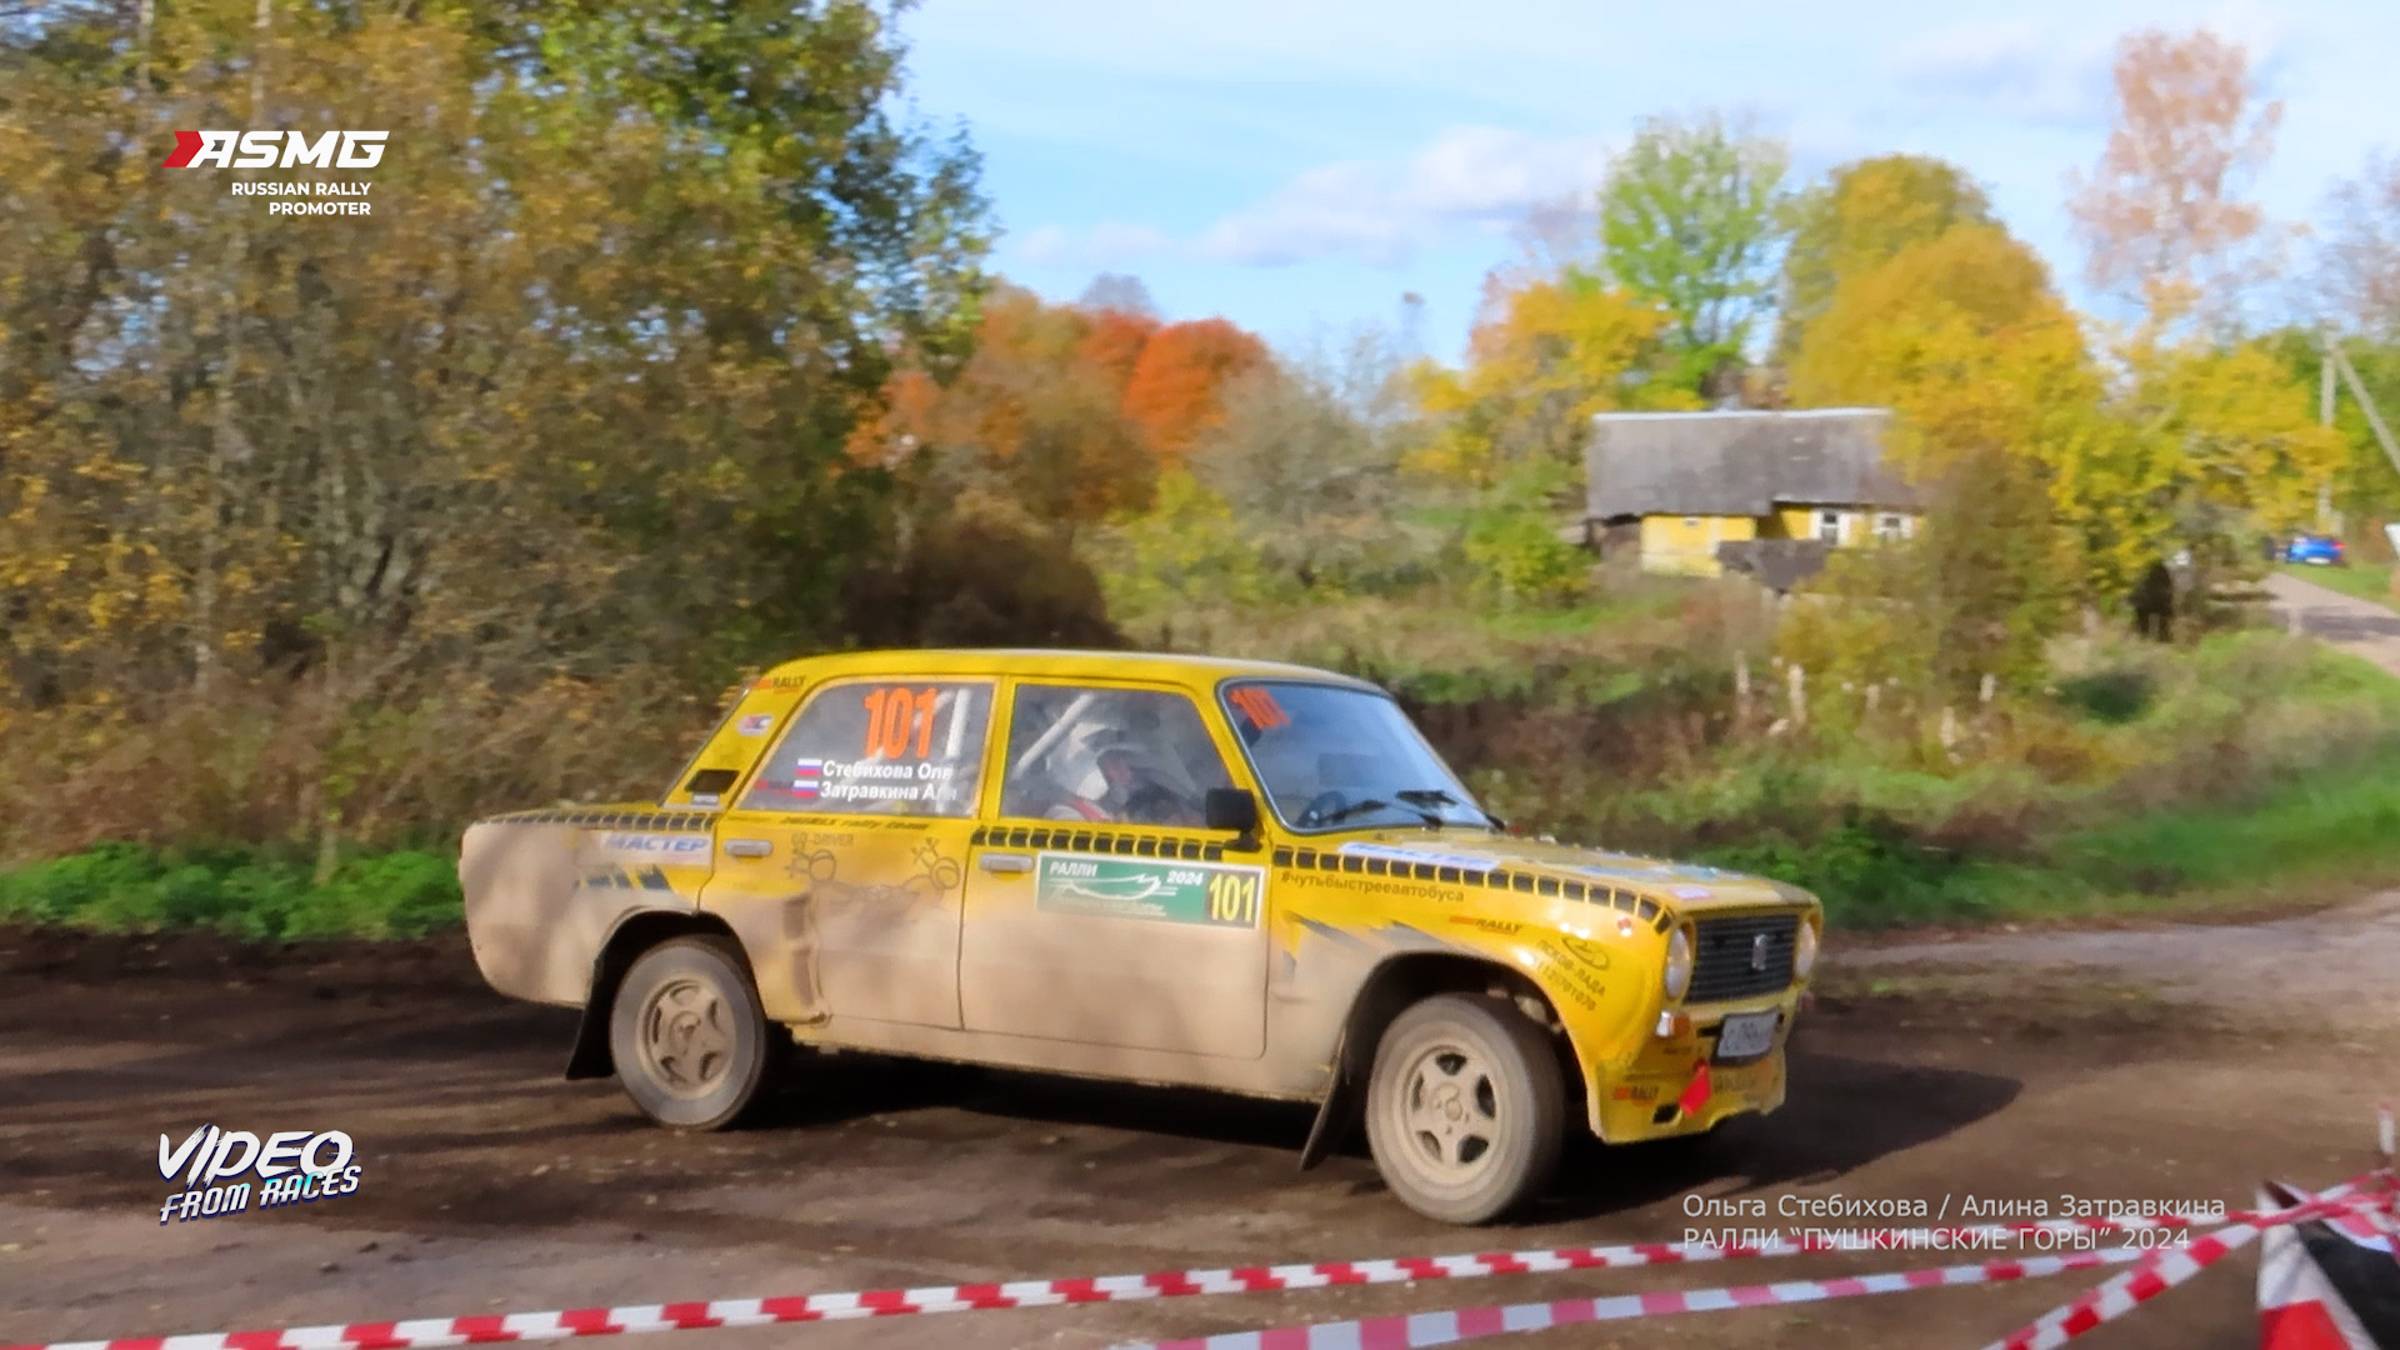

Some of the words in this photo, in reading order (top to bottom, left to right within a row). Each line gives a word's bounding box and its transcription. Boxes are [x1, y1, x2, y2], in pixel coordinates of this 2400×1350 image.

[863, 687, 940, 760] 101
[822, 759, 913, 779] Стебихова
[820, 780, 917, 802] Затравкина
[1049, 861, 1098, 877] РАЛЛИ
[1166, 870, 1204, 886] 2024
[1209, 873, 1256, 922] 101
